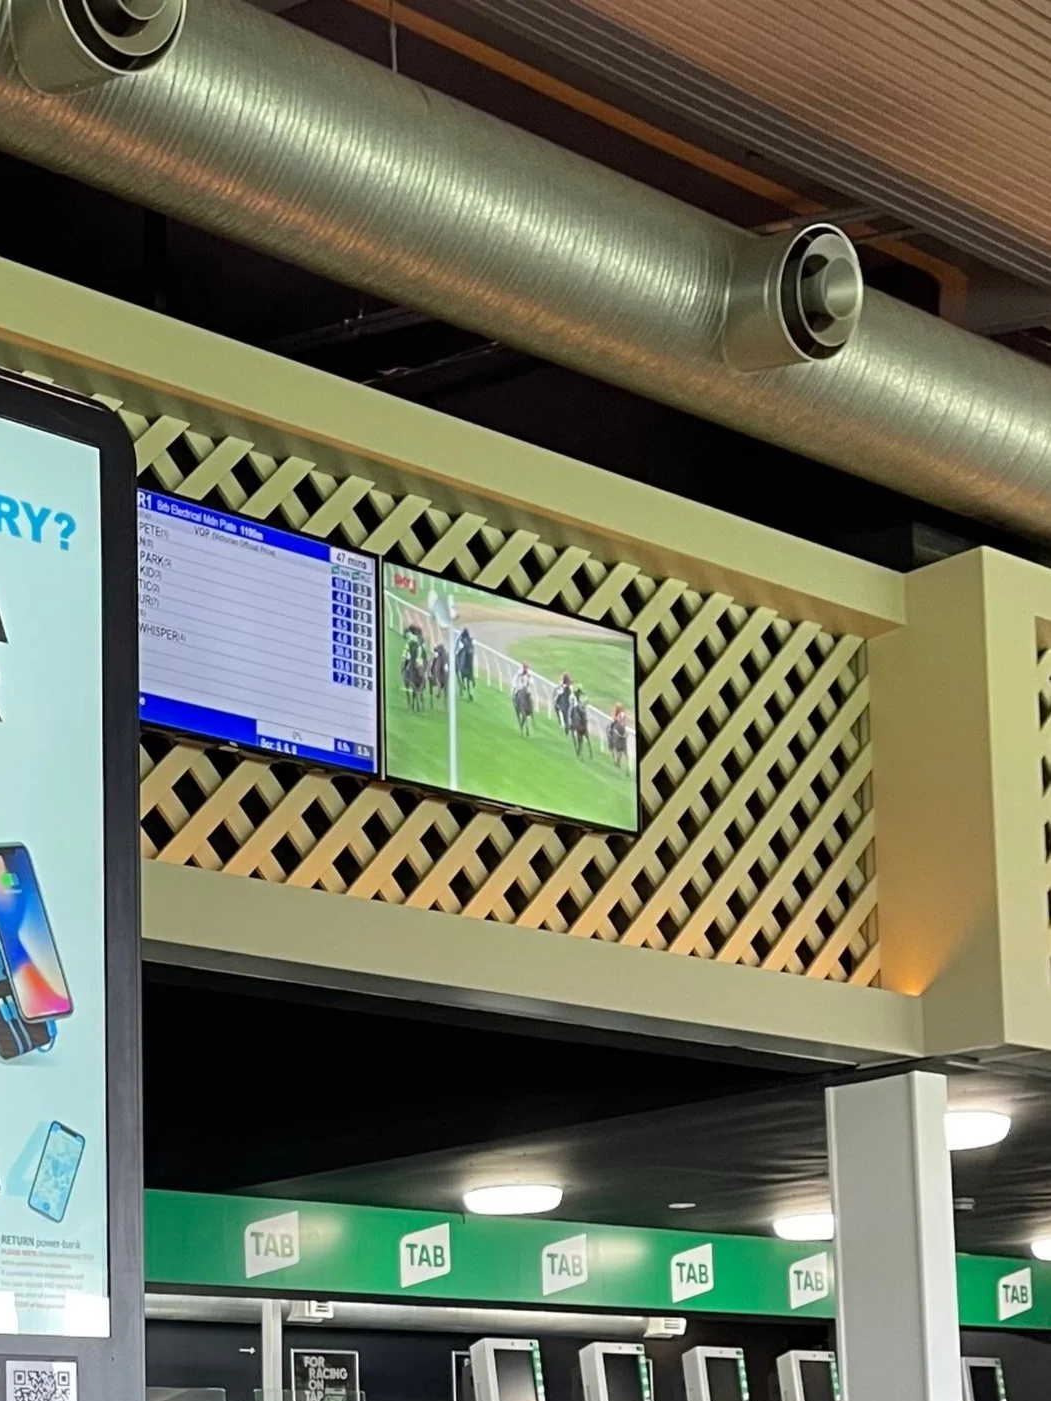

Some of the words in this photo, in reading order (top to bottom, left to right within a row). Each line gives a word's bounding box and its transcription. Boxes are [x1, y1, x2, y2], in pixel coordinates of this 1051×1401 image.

[137, 491, 152, 509] R1
[336, 552, 346, 563] 47
[348, 557, 367, 570] mins
[1, 1235, 35, 1246] RETURN
[250, 1231, 295, 1258] TAB
[406, 1243, 445, 1268] TAB
[546, 1252, 584, 1277] TAB
[675, 1261, 709, 1285] TAB
[793, 1269, 825, 1292] TAB
[1002, 1283, 1030, 1304] TAB
[303, 1356, 325, 1368] FOR
[309, 1368, 348, 1380] RACING
[309, 1380, 324, 1391] ON
